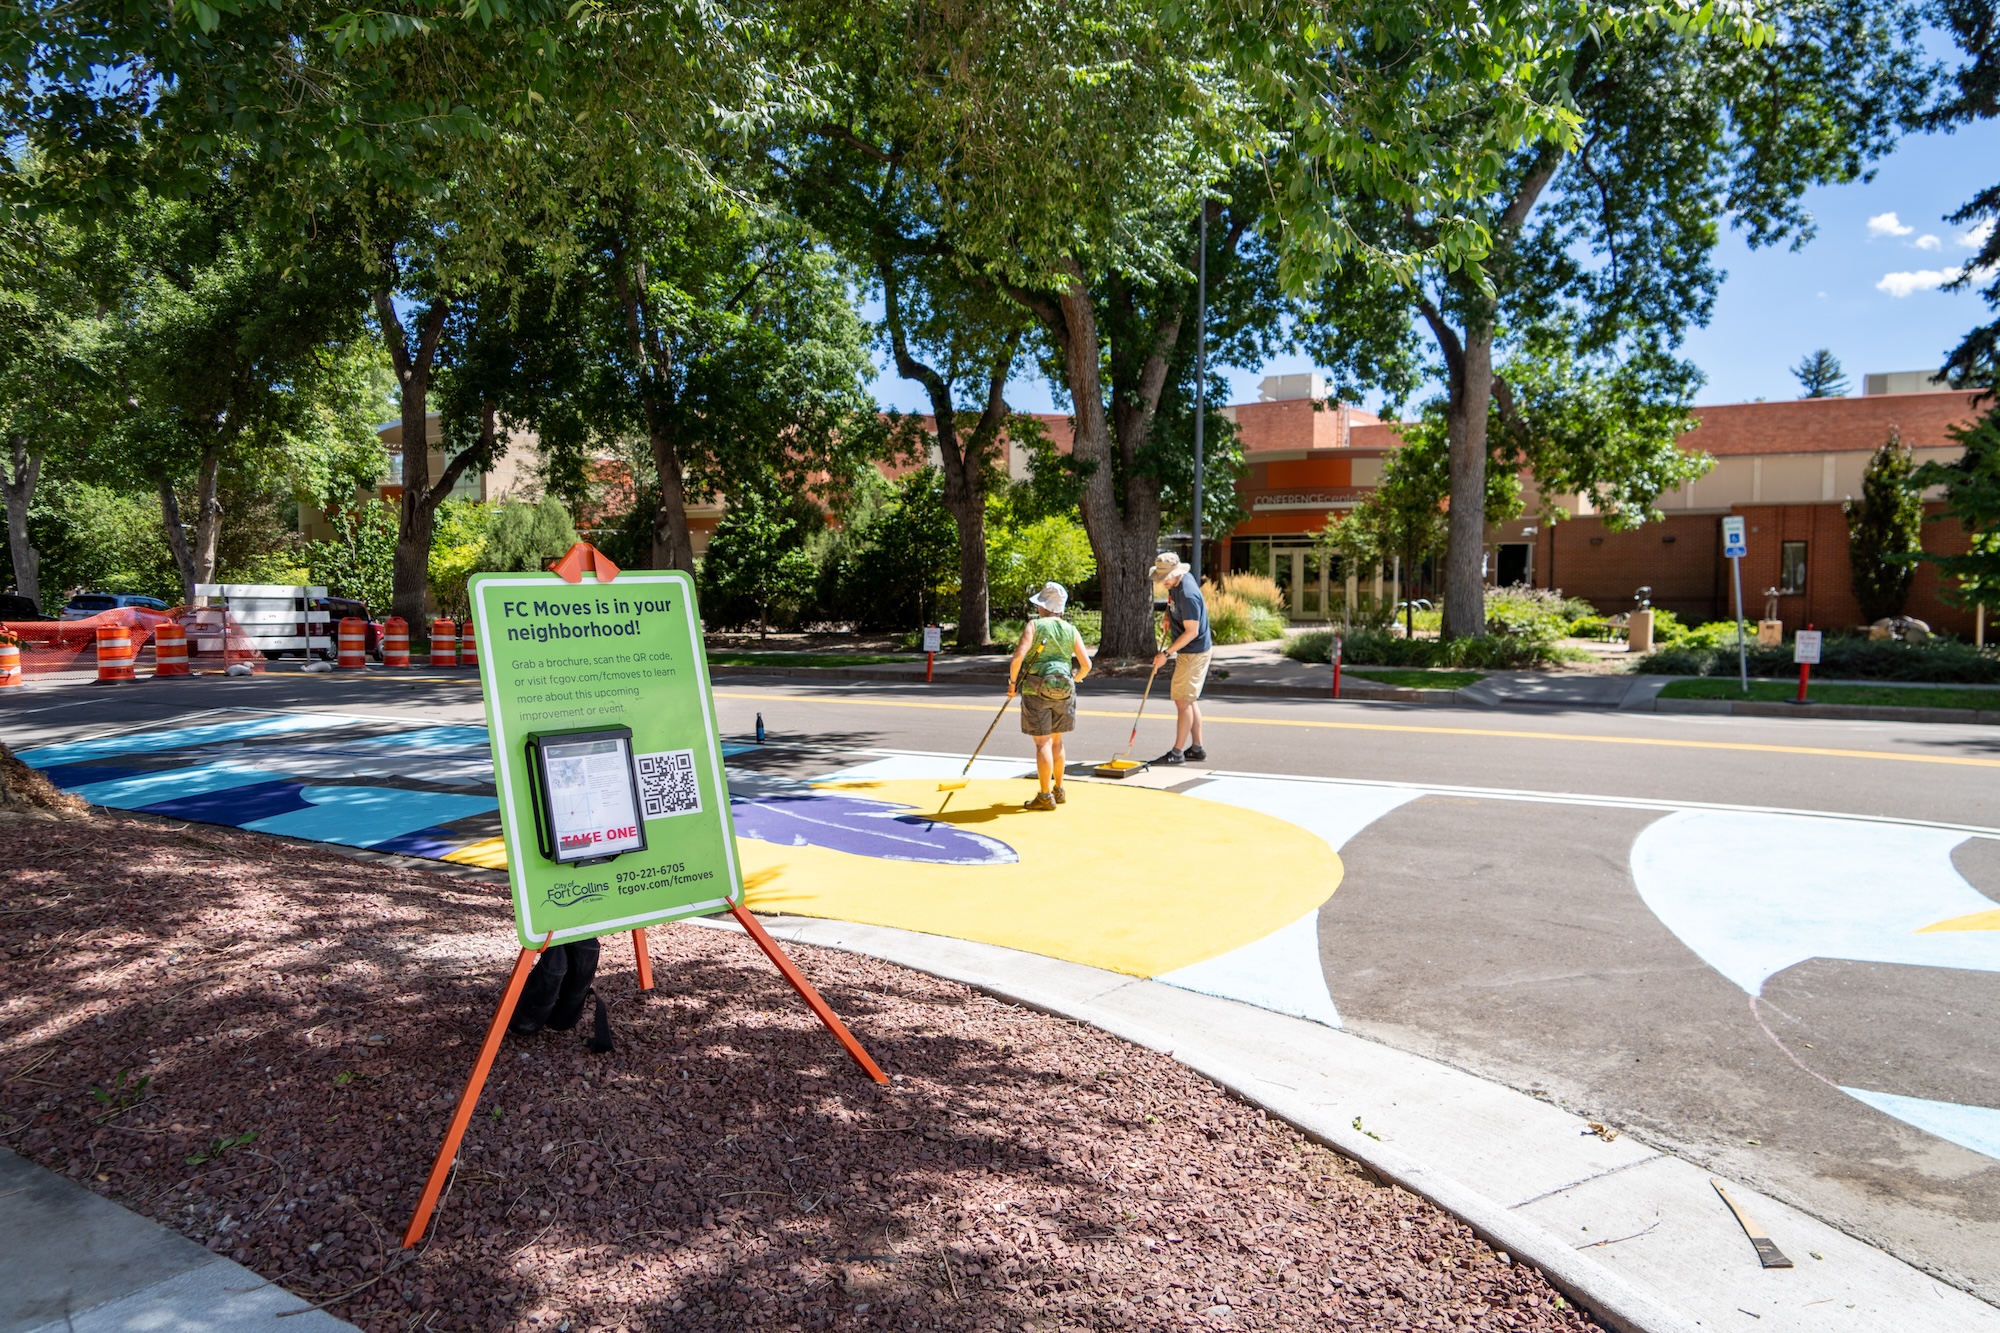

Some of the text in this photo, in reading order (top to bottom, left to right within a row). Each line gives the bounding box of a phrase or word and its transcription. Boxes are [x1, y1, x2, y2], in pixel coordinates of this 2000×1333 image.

[503, 598, 671, 618] FC Moves is in your
[507, 620, 641, 643] neighborhood!
[511, 652, 673, 670] Grab a brochure, scan the QR code,
[514, 668, 676, 687] or visit fcgov.com/fcmoves to learn
[517, 686, 640, 704] more about this upcoming
[519, 704, 627, 721] improvement or event.
[561, 826, 638, 847] TAKE ONE
[616, 862, 686, 883] 970-221-6705
[547, 881, 610, 900] Fort Collins
[553, 880, 575, 890] City of
[617, 870, 714, 895] fcgov.com/fcmoves
